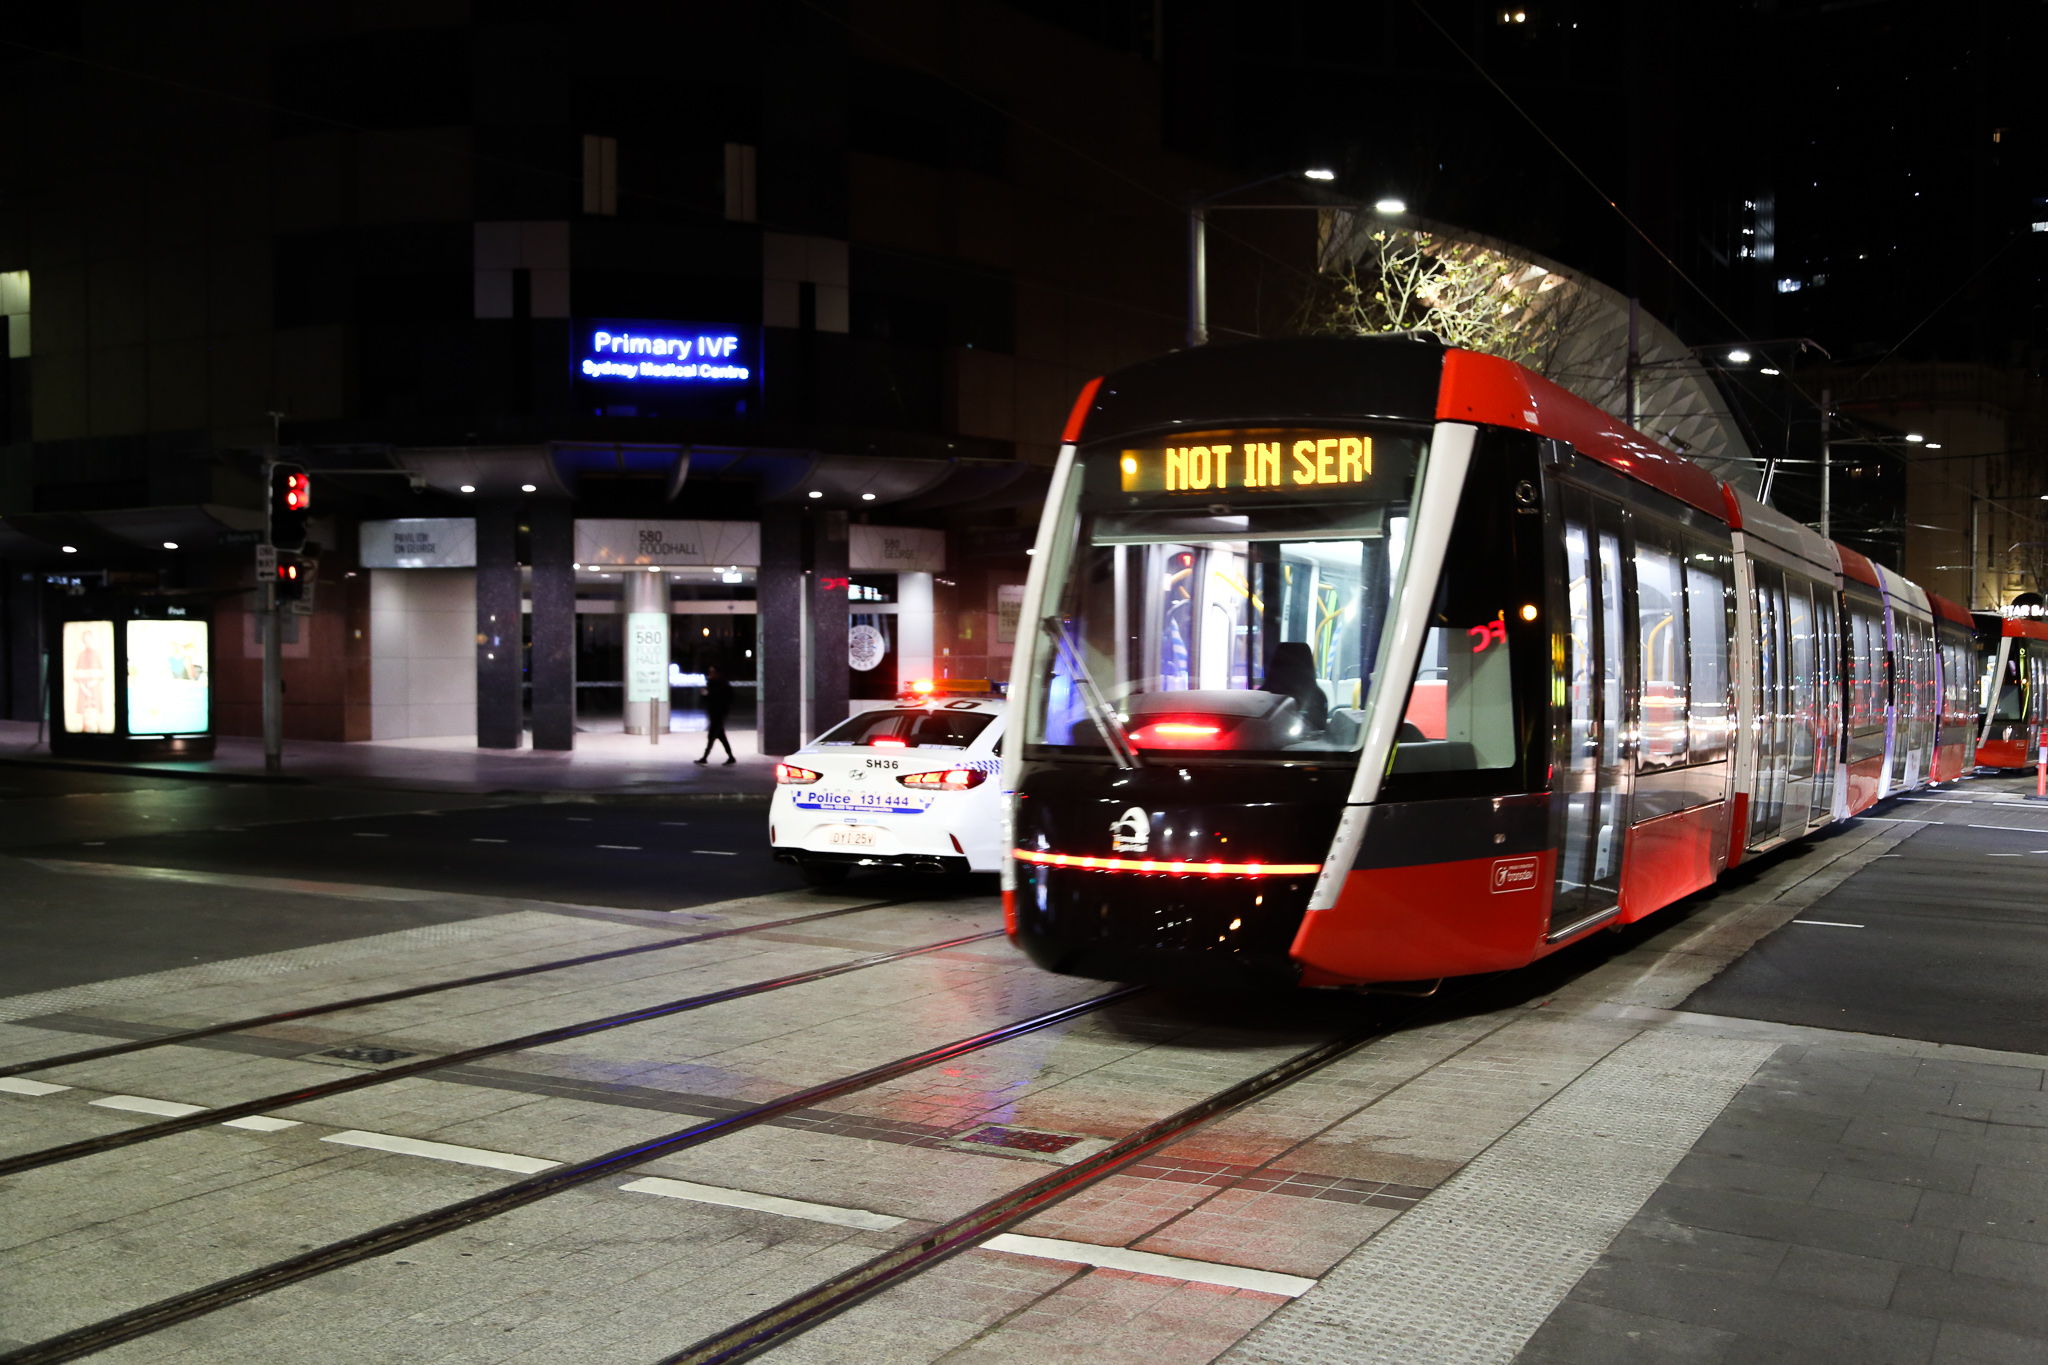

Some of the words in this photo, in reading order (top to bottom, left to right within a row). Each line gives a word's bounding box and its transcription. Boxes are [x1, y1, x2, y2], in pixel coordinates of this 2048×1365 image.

[594, 331, 692, 361] Primary
[698, 336, 738, 357] IVF
[582, 359, 638, 379] Sydney
[639, 361, 697, 377] Medical
[699, 363, 749, 380] Centre
[1165, 444, 1232, 491] NOT
[1243, 441, 1281, 488] IN
[639, 530, 662, 543] 580
[407, 543, 437, 554] GEORGE
[639, 543, 698, 555] FOODHALL
[884, 538, 900, 549] 580
[2000, 604, 2030, 617] STAR
[636, 631, 662, 644] 580
[865, 758, 899, 769] SH36
[808, 792, 851, 804] Police
[861, 794, 881, 805] 131
[885, 796, 909, 807] 444
